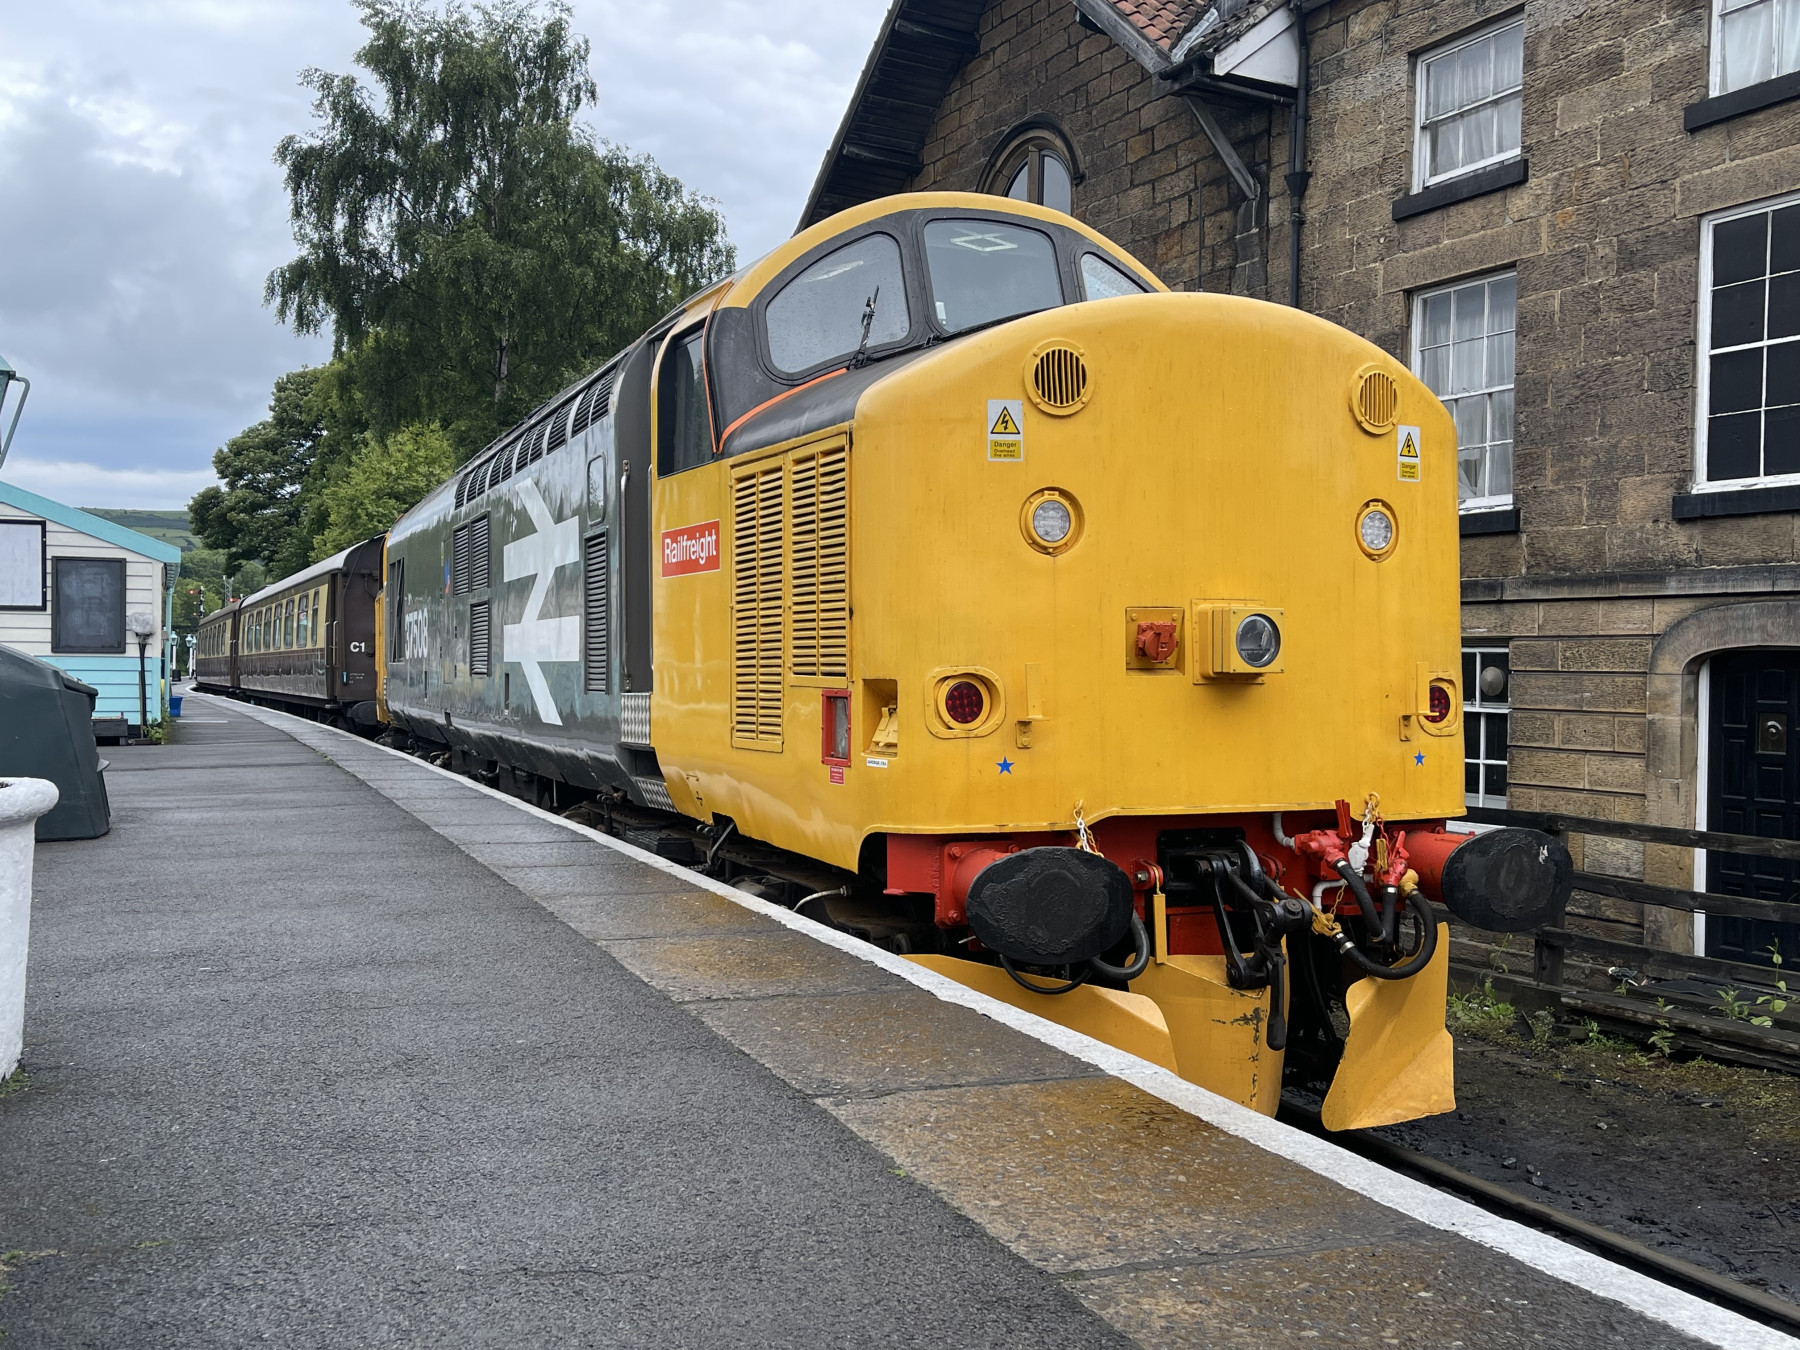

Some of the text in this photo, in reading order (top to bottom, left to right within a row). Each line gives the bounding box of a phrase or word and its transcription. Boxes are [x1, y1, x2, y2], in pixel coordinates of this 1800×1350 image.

[994, 441, 1017, 449] Danger
[664, 528, 717, 565] Railfreight
[404, 607, 429, 660] 37508
[350, 641, 366, 653] C1
